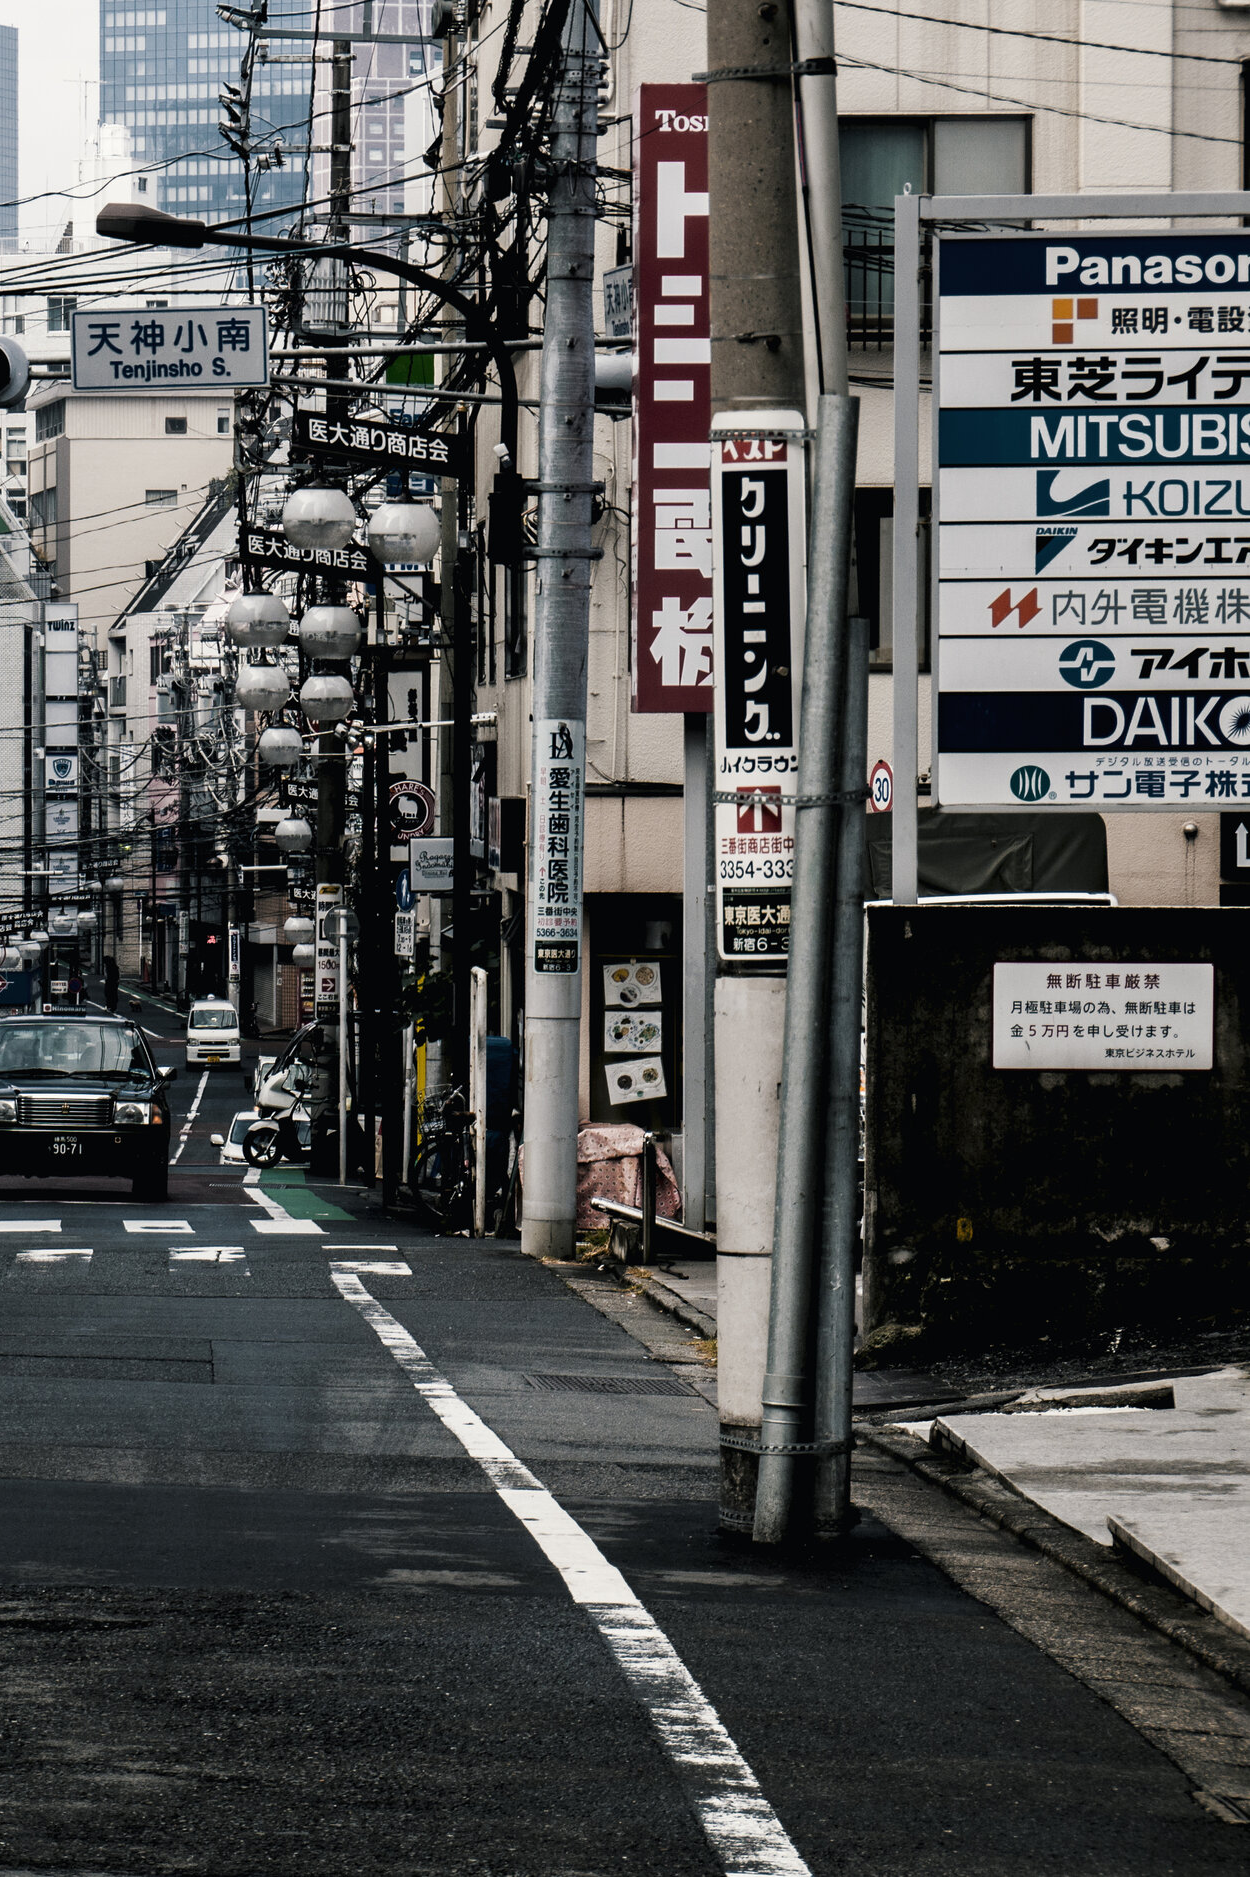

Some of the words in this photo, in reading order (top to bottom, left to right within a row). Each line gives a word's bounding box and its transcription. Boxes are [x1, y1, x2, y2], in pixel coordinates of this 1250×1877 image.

[1111, 306, 1250, 335] 照明・電設
[87, 316, 251, 358] 天神小南
[110, 359, 202, 383] Tenjinsho
[212, 357, 231, 378] S.
[308, 417, 449, 464] 医大通り商店会
[1036, 527, 1078, 535] DAIKIN
[740, 476, 780, 742] クリーニング
[875, 777, 890, 802] 30
[1065, 770, 1250, 799] サン電子株
[548, 767, 570, 903] 愛生歯科医院
[1046, 973, 1161, 990] 無断駐車厳禁
[1010, 1001, 1196, 1015] 月極駐車場の為、無断駐車は
[1105, 1048, 1196, 1059] 東京ビジネスホテル
[53, 1143, 82, 1155] 90-71
